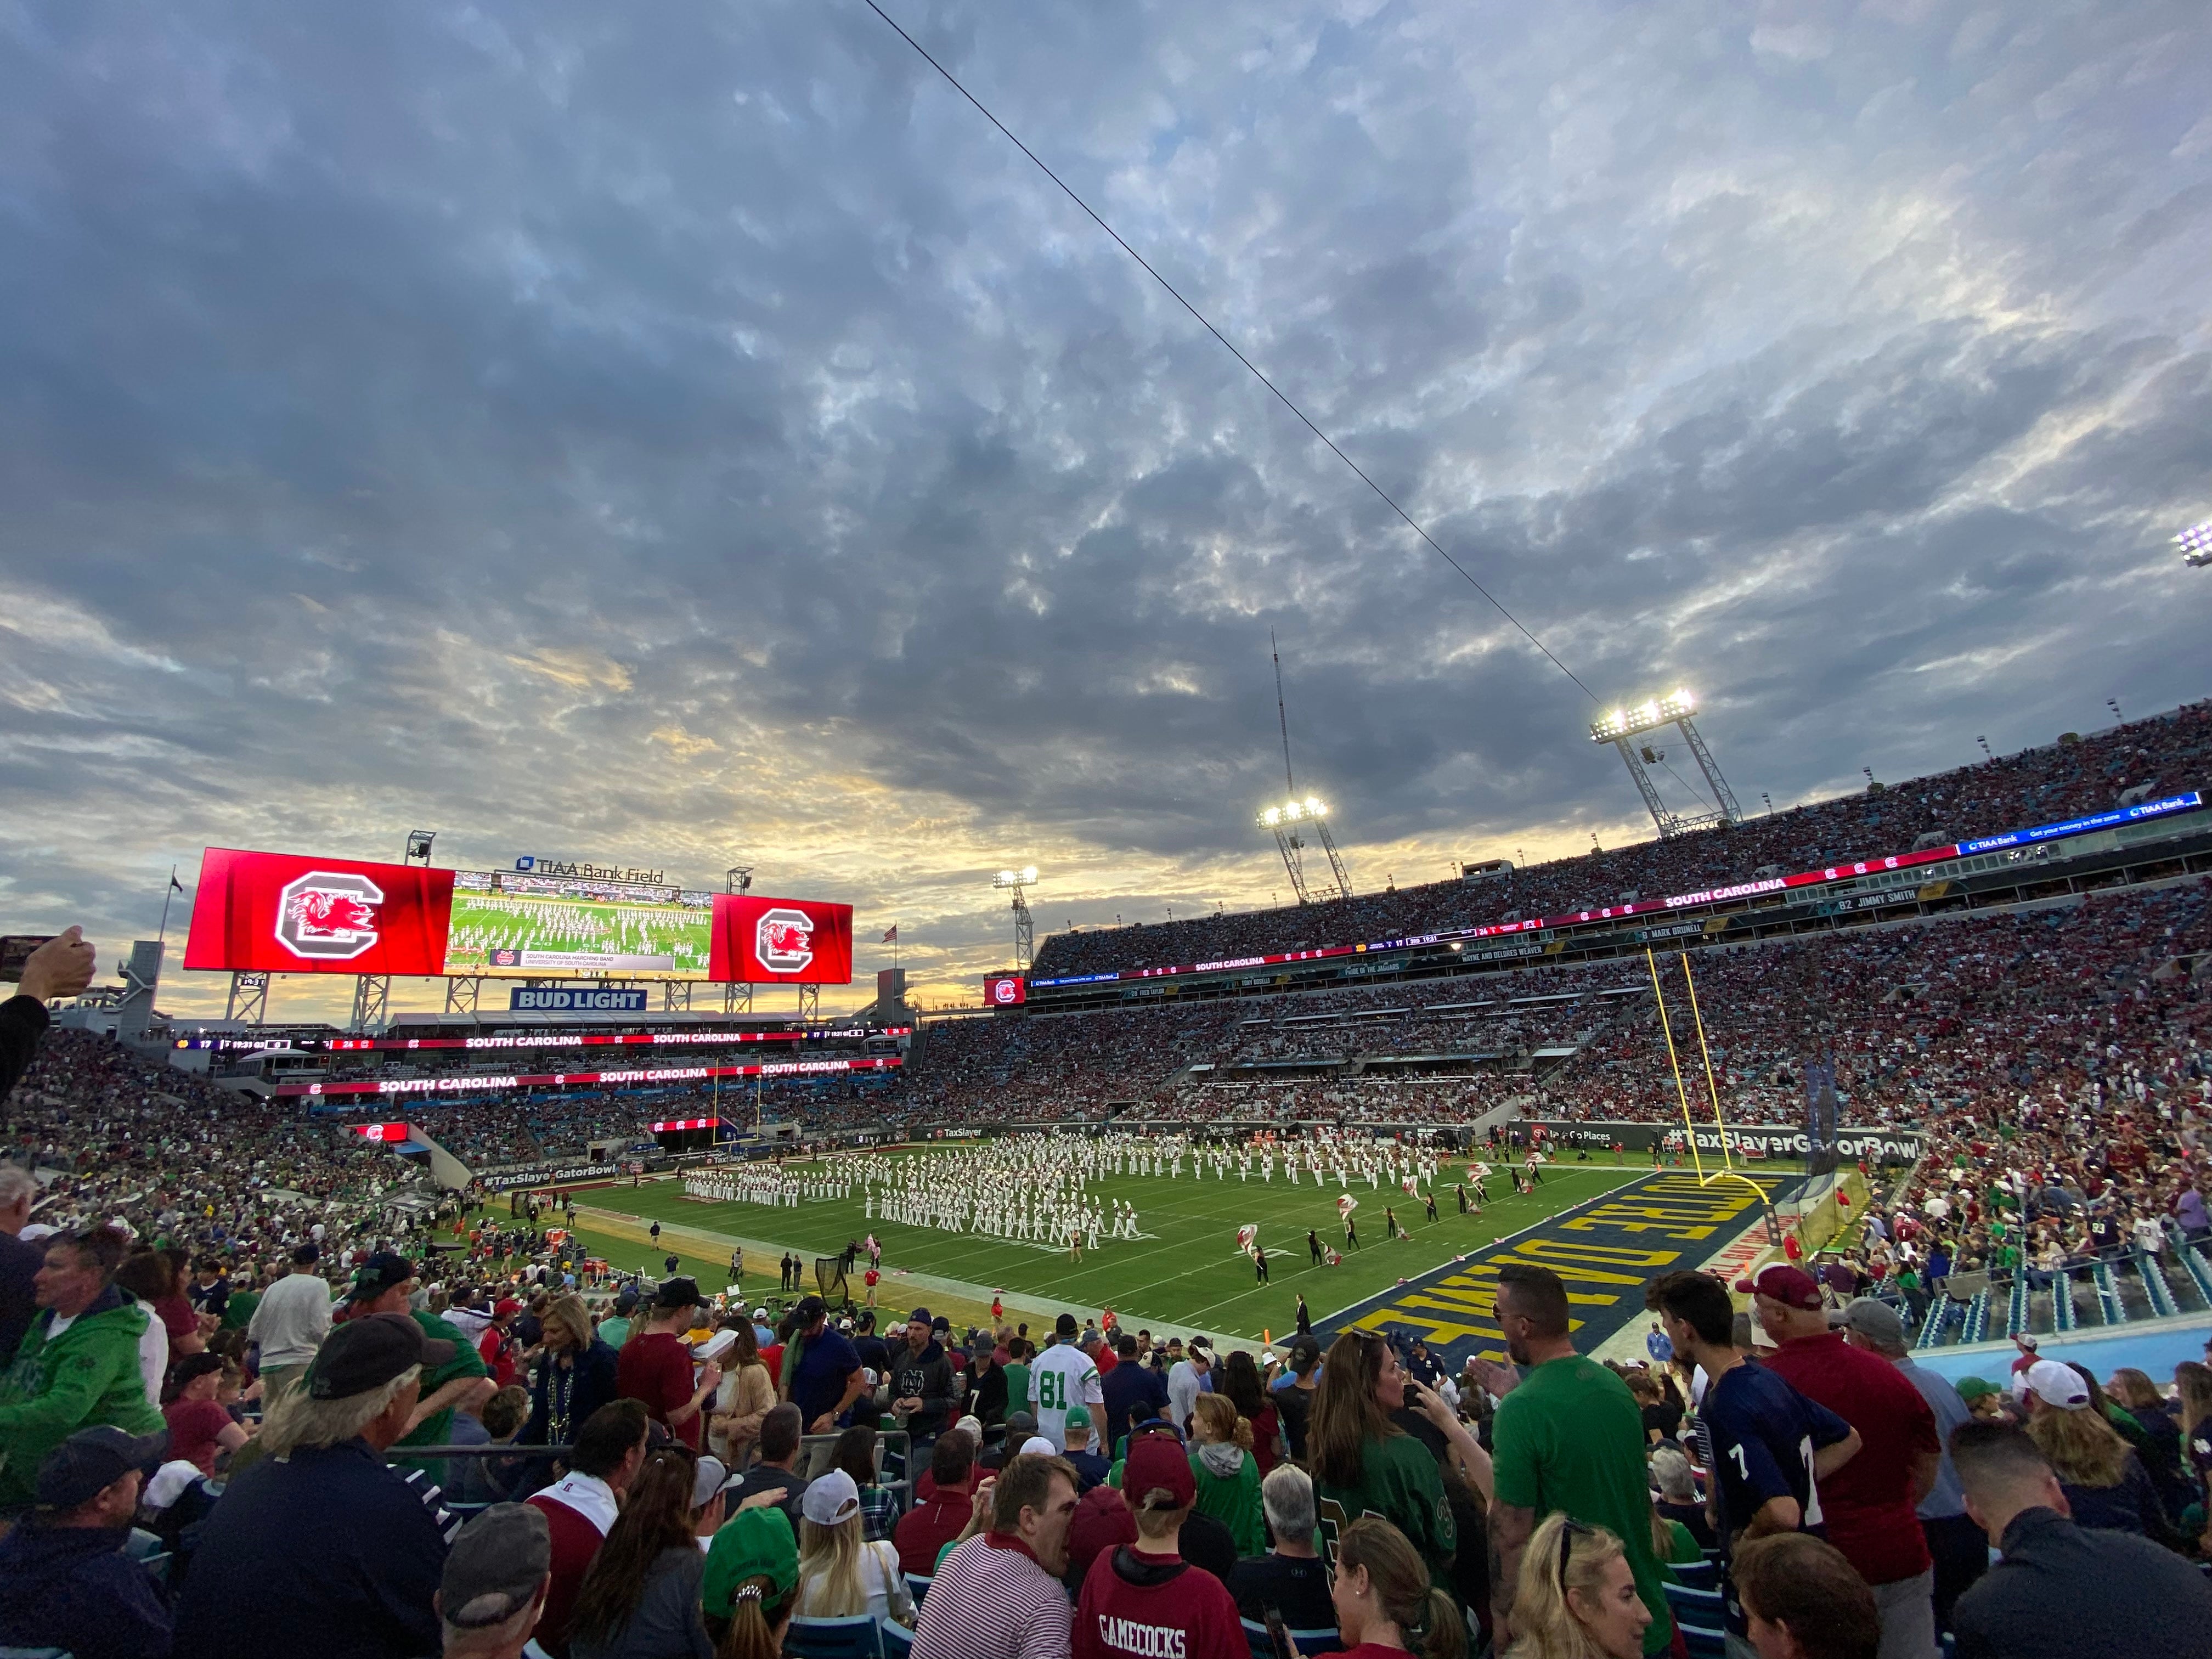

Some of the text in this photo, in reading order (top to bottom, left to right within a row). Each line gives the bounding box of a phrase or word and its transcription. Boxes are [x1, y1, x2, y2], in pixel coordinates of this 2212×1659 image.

[2139, 804, 2162, 814] TIAA
[1977, 834, 2018, 848] TIAA Bank
[537, 859, 663, 884] TIAA Bank Field
[1665, 878, 1787, 907] SOUTH CAROLINA
[1838, 900, 1853, 910] 82
[1858, 895, 1884, 907] JIMMY
[1887, 889, 1916, 902] SMITH
[1651, 928, 1671, 938] MARK
[1672, 924, 1702, 935] BRUNELL
[1462, 946, 1542, 962] WAYNE AND DELORES WEAVER
[1196, 956, 1265, 971] SOUTH CAROLINA
[1377, 963, 1400, 972] JAGUARS
[518, 991, 641, 1010] BUD LIGHT
[200, 1040, 212, 1048] 17
[466, 1036, 582, 1047] SOUTH CAROLINA
[653, 1033, 741, 1043] SOUTH CAROLINA
[762, 1060, 850, 1074] SOUTH CAROLINA
[600, 1068, 708, 1082] SOUTH CAROLINA
[379, 1076, 517, 1092] SOUTH CAROLINA
[944, 1127, 982, 1138] TaxSlayer
[1584, 1131, 1610, 1141] Places
[1040, 1370, 1067, 1410] 81
[970, 1389, 980, 1413] 7
[1728, 1443, 1750, 1481] 7
[1098, 1613, 1187, 1659] GAMECOCKS
